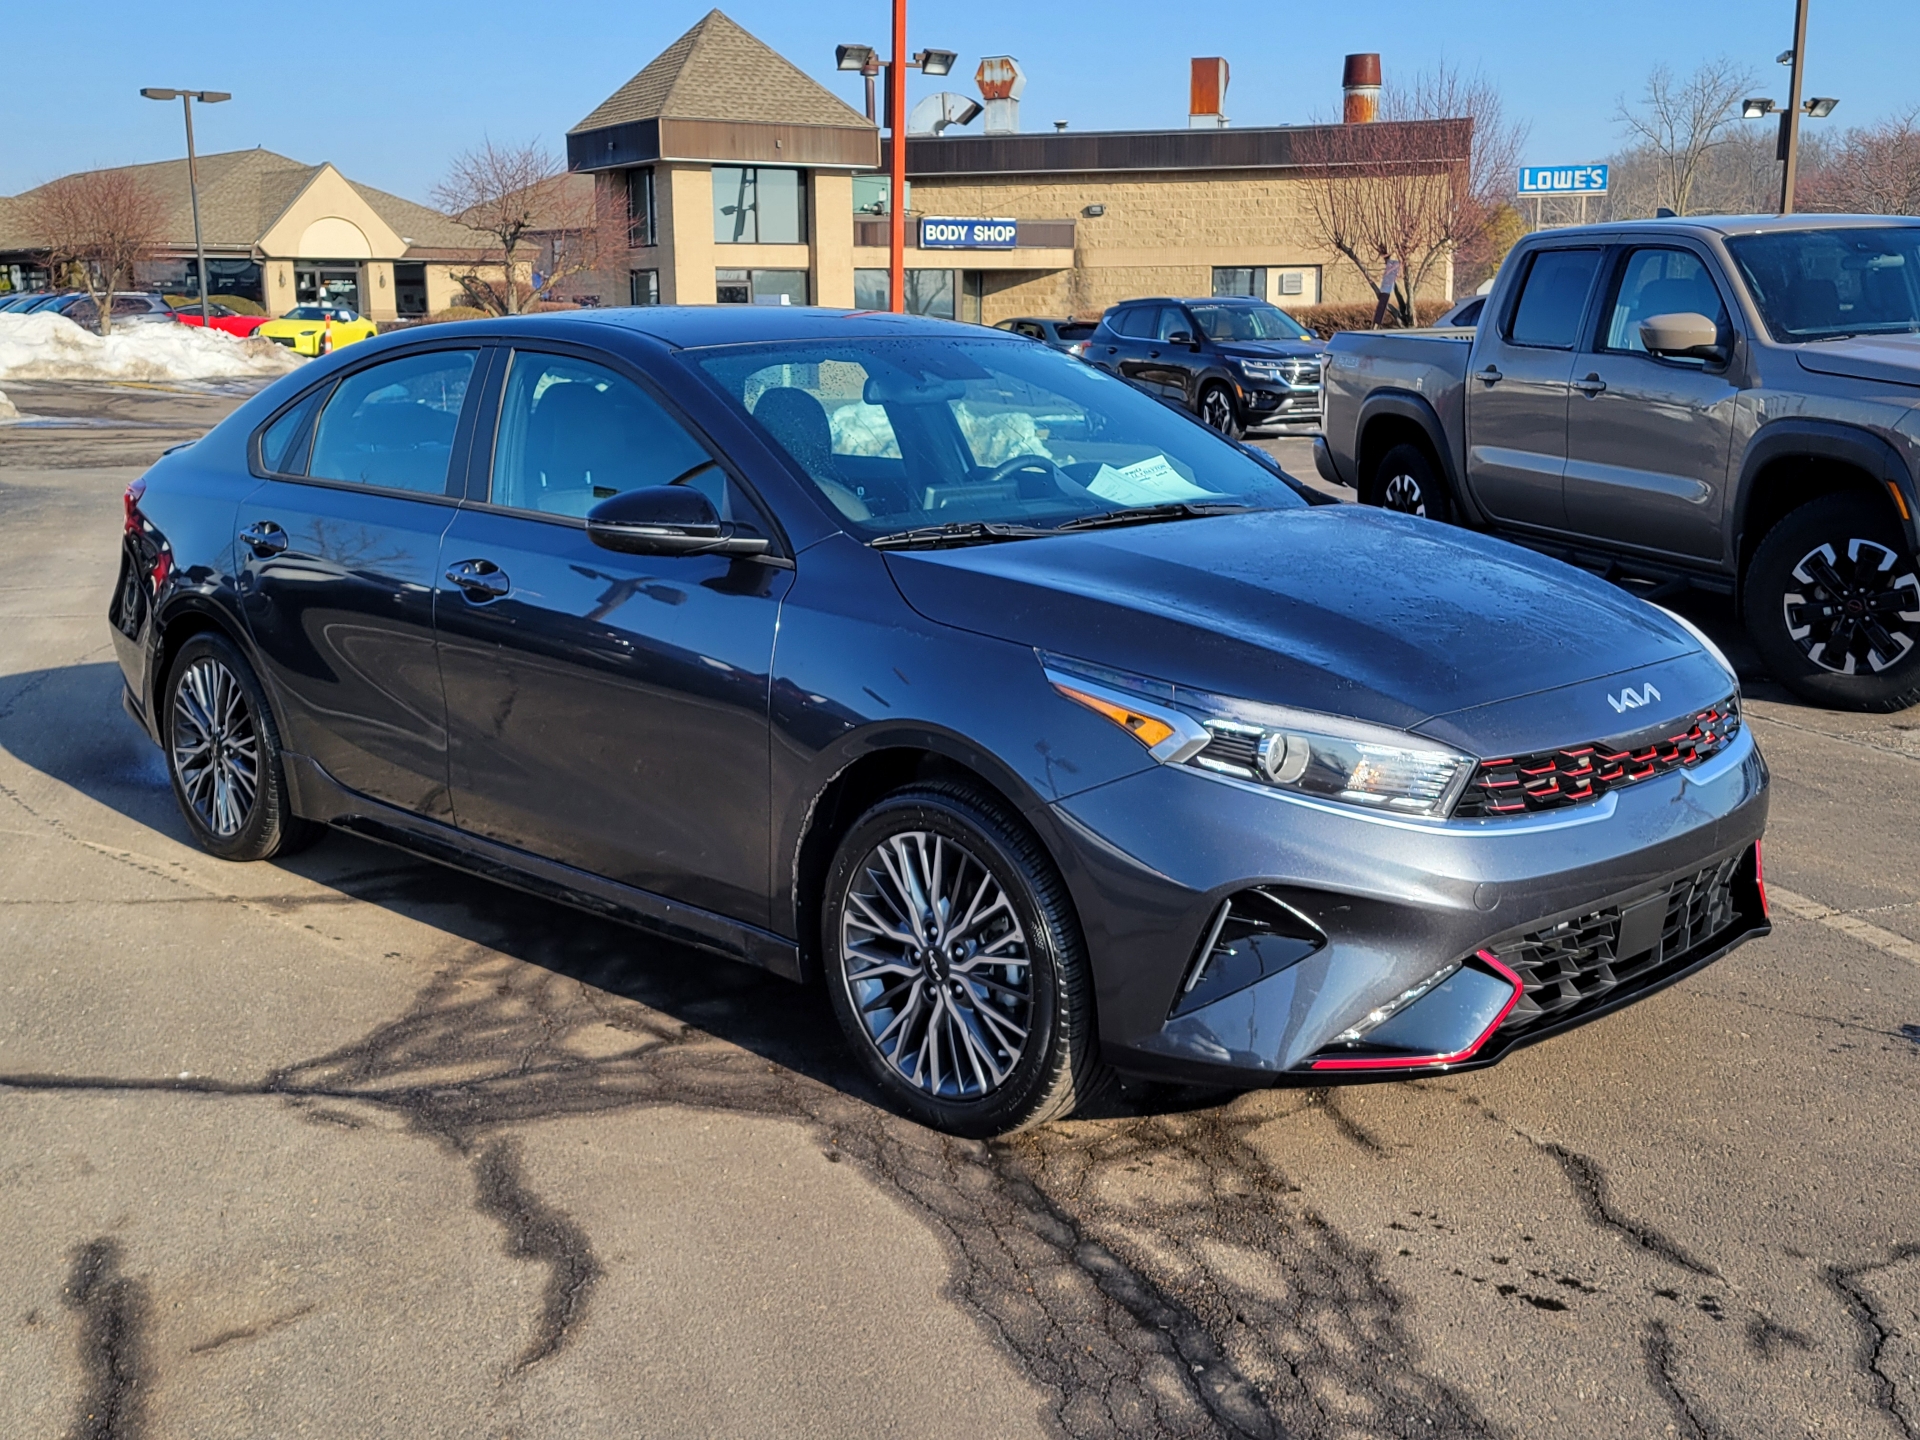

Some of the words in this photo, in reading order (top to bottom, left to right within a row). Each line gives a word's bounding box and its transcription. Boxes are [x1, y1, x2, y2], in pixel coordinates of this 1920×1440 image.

[1523, 167, 1603, 190] LOWE'S
[925, 225, 968, 241] BODY
[973, 226, 1016, 242] SHOP
[1607, 682, 1661, 713] KIA
